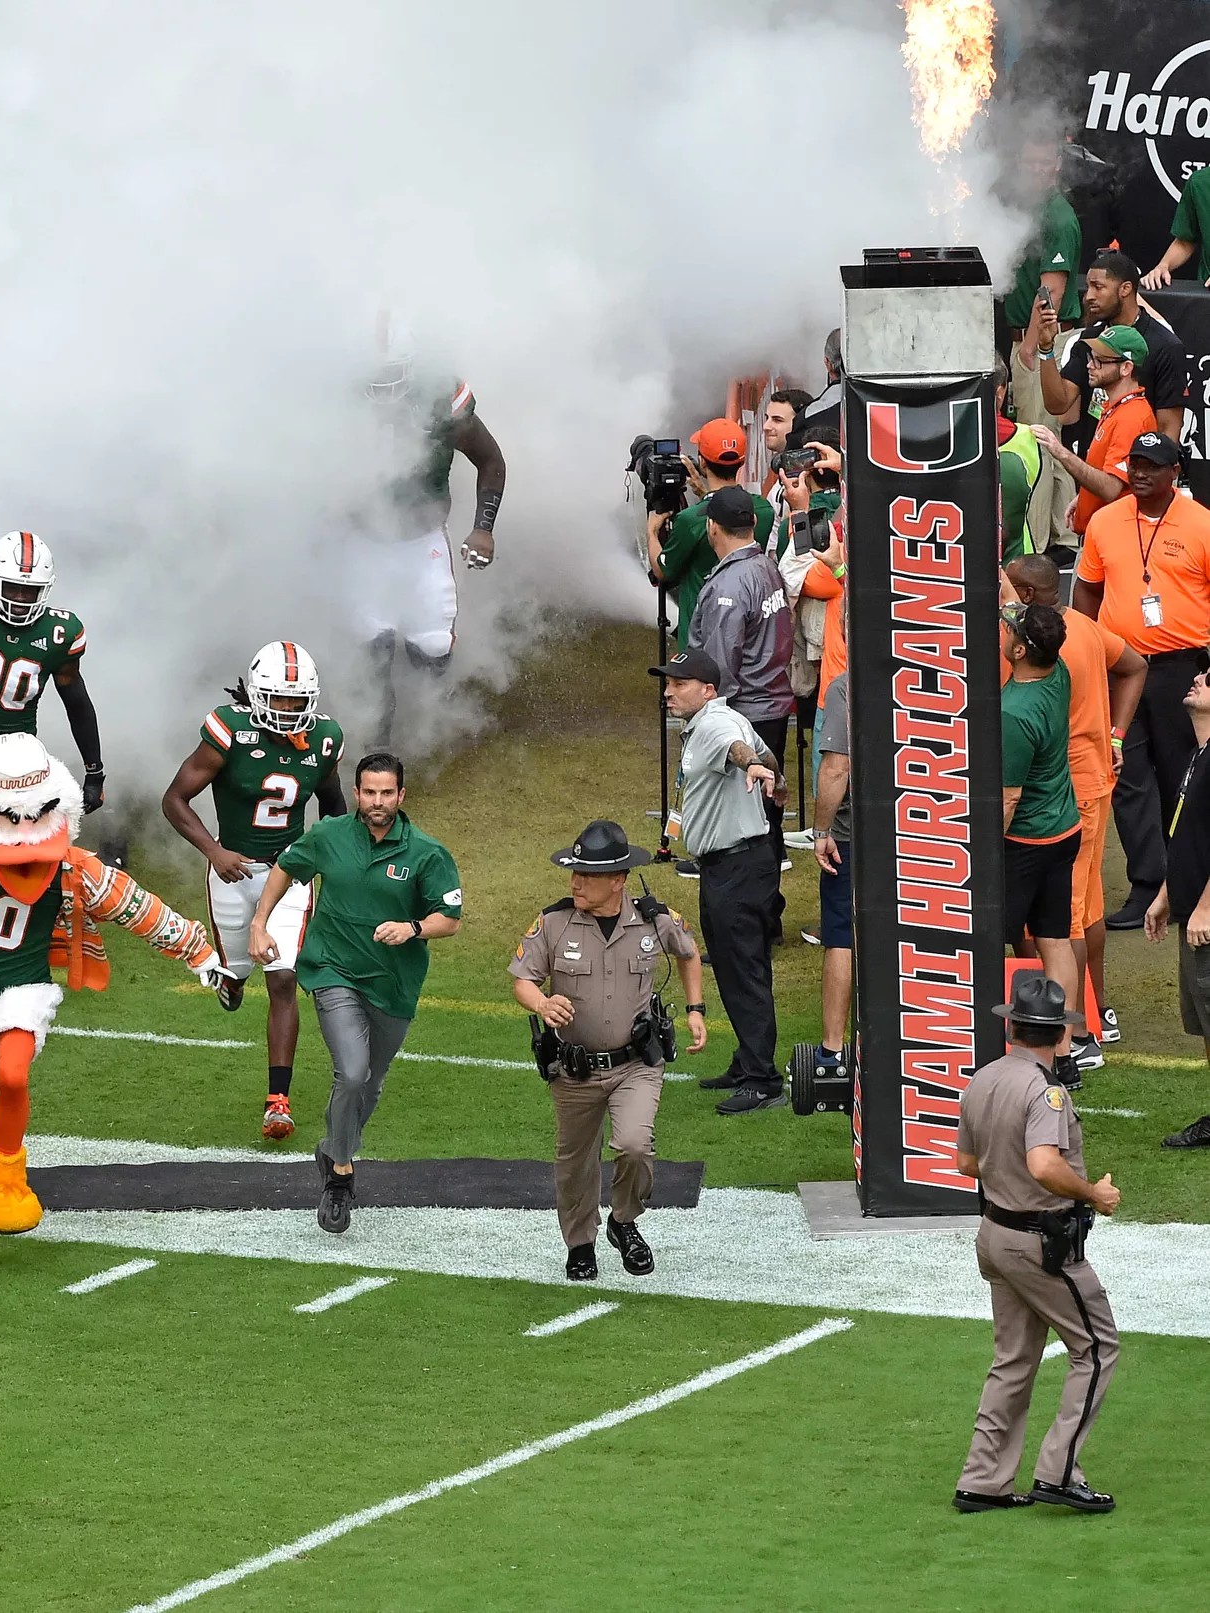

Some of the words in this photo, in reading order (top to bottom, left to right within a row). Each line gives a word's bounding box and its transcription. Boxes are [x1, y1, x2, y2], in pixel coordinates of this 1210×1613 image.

[865, 397, 984, 474] U
[52, 625, 65, 645] C
[889, 495, 973, 934] HURRICANES
[321, 736, 334, 756] C
[251, 772, 300, 830] 2
[386, 863, 410, 881] U
[898, 941, 979, 1193] MIAMI
